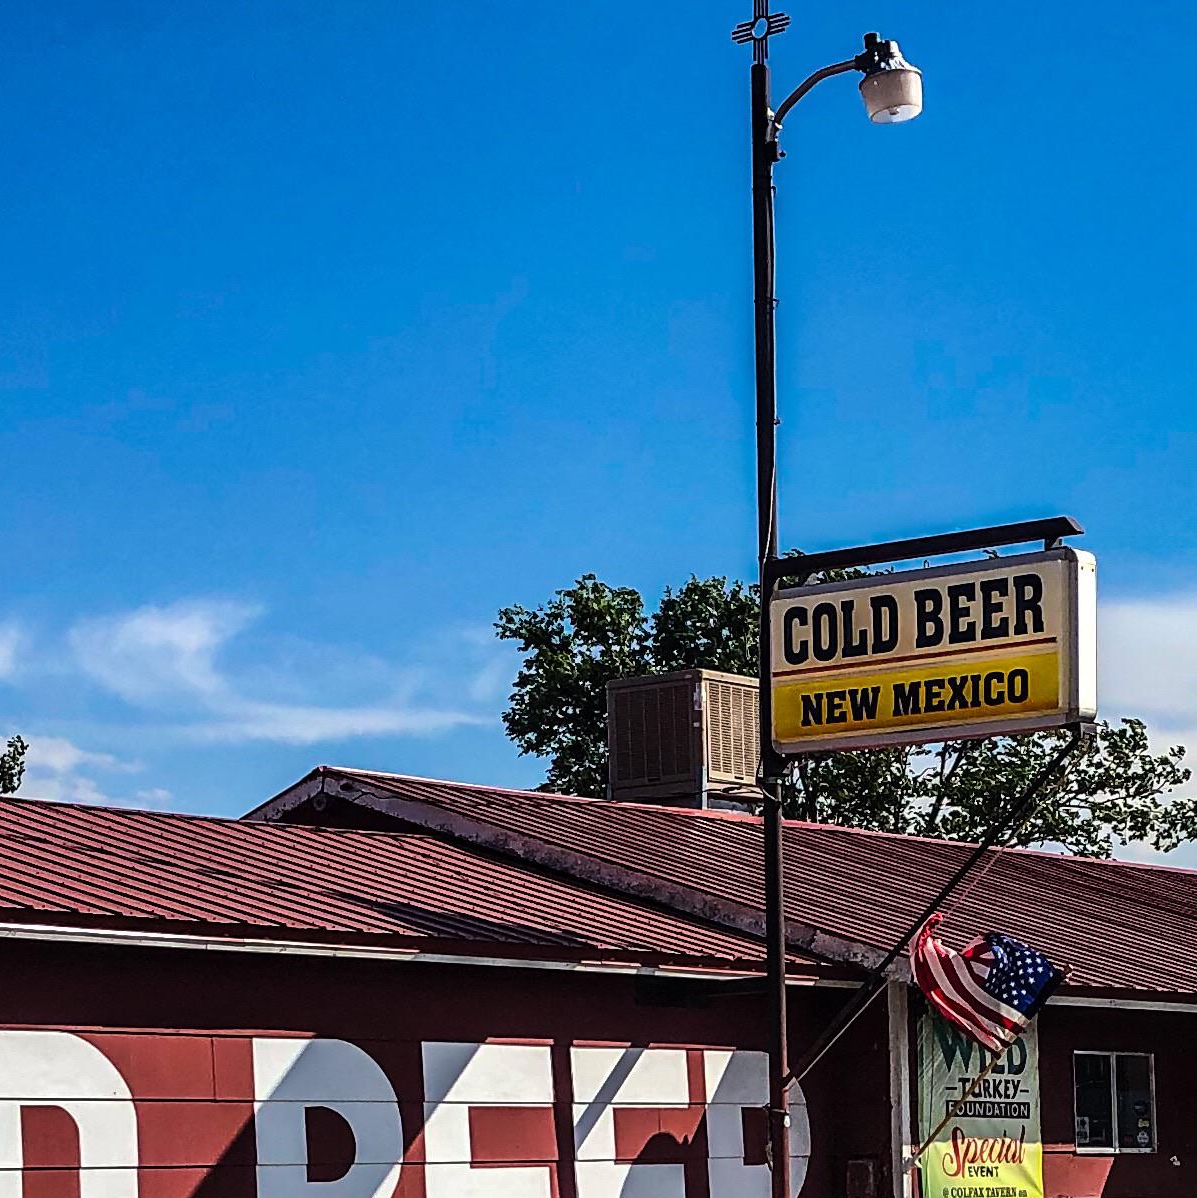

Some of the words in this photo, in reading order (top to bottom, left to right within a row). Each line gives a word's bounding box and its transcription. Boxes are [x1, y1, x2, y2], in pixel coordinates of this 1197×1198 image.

[783, 593, 899, 666] COLD
[914, 573, 1045, 649] BEER
[801, 685, 881, 727] NEW
[892, 668, 1030, 717] MEXICO
[947, 1103, 1028, 1117] FOUNDATION
[942, 1124, 1026, 1179] Special
[967, 1165, 1000, 1178] EVENT
[950, 1187, 985, 1198] COLFAX
[985, 1187, 1017, 1198] TAVERN
